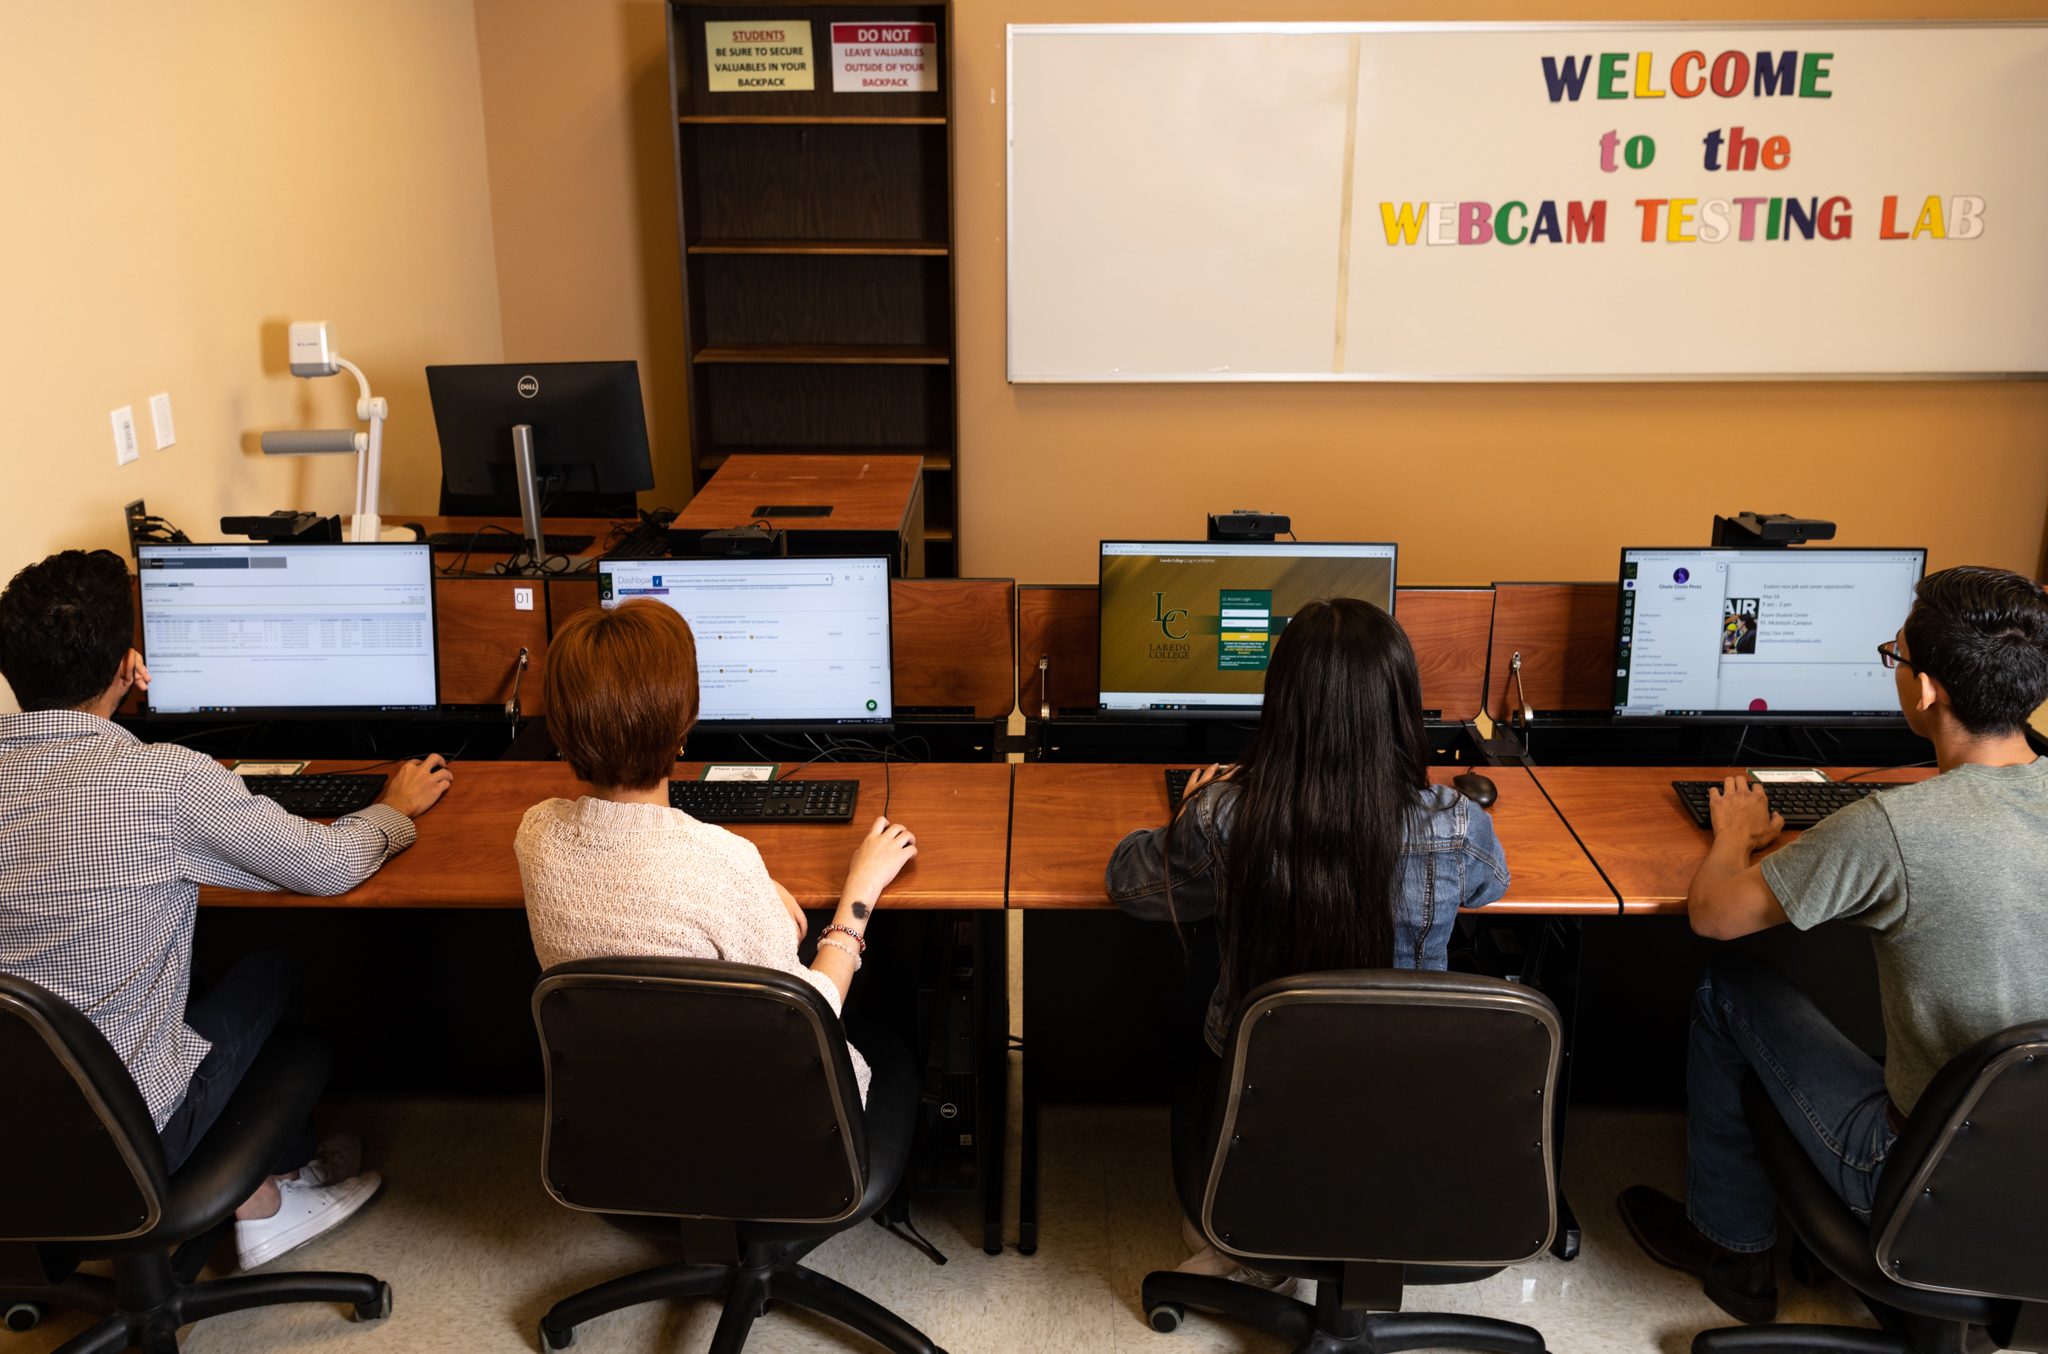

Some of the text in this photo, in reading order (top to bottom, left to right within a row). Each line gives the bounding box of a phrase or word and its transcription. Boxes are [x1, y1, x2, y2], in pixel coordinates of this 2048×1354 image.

[732, 30, 785, 42] STUDENTS
[858, 29, 911, 42] DO NOT
[716, 46, 803, 57] BE SURE TO SECURE
[845, 48, 924, 57] LEAVE VALUABLES
[714, 62, 806, 72] VALUABLES IN YOUR
[845, 63, 925, 72] OUTSIDE OF YOUR
[1541, 50, 1834, 103] WELCOME
[738, 78, 785, 87] BACKPACK
[862, 78, 908, 87] BACKPACK
[1599, 126, 1791, 173] to the
[1379, 195, 1986, 246] WEBCAM TESTING LAB
[520, 383, 536, 391] DELL
[618, 576, 653, 584] Dashboar
[516, 592, 529, 604] 01
[1725, 600, 1757, 615] AIR
[1152, 592, 1188, 640] LC
[1149, 643, 1190, 652] LAREDO
